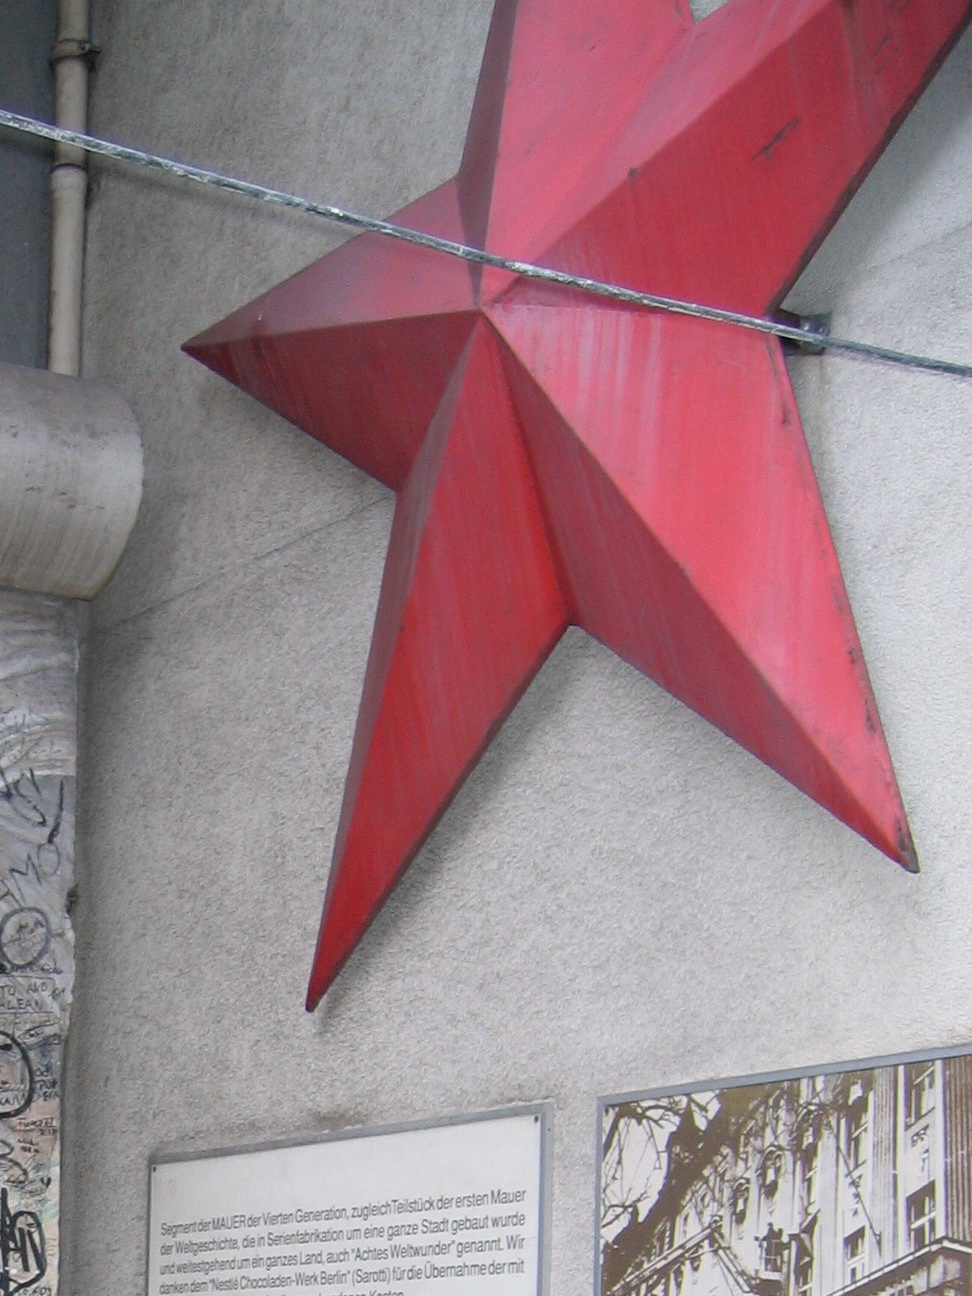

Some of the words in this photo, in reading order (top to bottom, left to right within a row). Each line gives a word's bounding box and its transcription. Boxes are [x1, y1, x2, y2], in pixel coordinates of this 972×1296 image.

[159, 1242, 173, 1255] der
[174, 1236, 239, 1255] Weltgeschichte,
[242, 1234, 255, 1248] die
[258, 1233, 265, 1247] in
[267, 1227, 344, 1246] Serienfabrikation
[346, 1228, 361, 1240] um
[363, 1224, 384, 1238] eine
[386, 1223, 418, 1240] ganze
[420, 1217, 449, 1234] Stadt
[451, 1215, 488, 1235] gebaut
[490, 1211, 525, 1228] wurde
